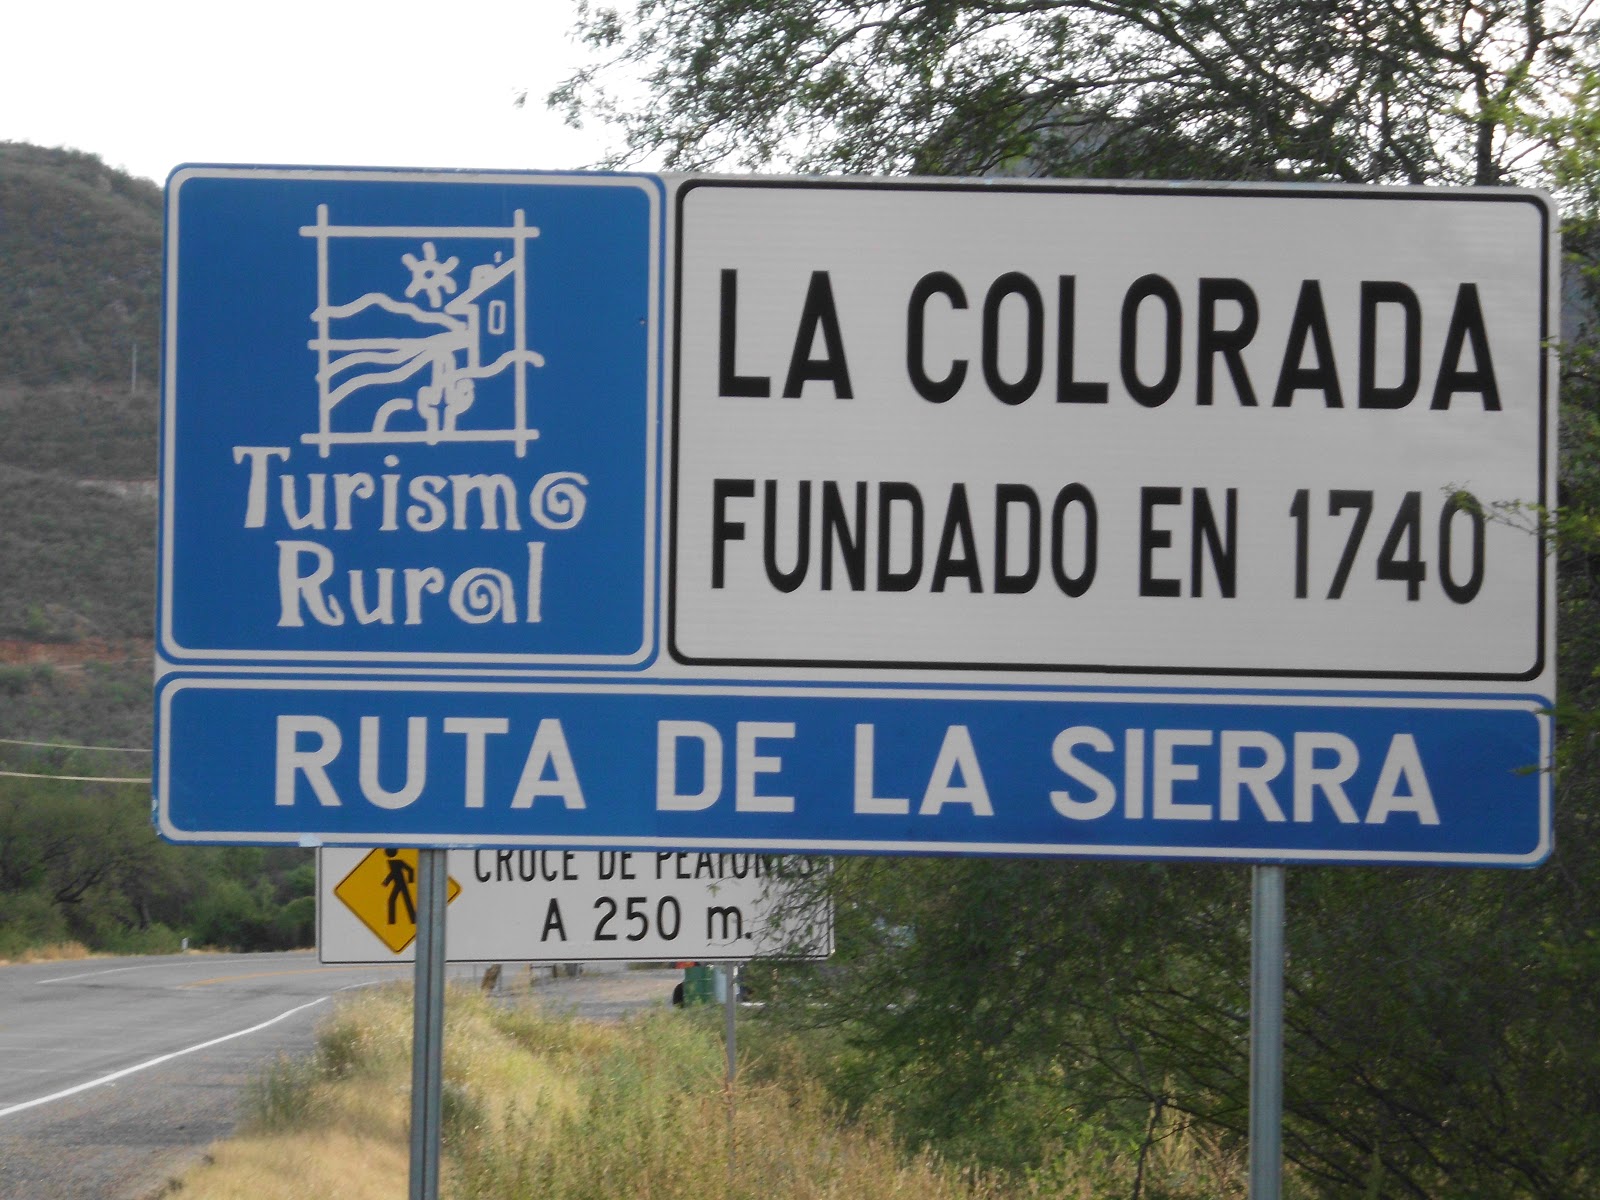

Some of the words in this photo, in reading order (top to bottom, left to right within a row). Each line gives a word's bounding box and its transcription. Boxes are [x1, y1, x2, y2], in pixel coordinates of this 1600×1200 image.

[718, 268, 854, 400] LA
[906, 270, 1503, 412] COLORADA
[233, 446, 589, 532] Turismo
[275, 540, 546, 628] Rural
[711, 478, 1099, 599] FUNDADO
[1138, 486, 1238, 599] EN
[1289, 488, 1486, 605] 1740
[275, 714, 586, 811] RUTA
[656, 719, 796, 814] DE
[854, 723, 994, 817] LA
[1050, 725, 1440, 826] SIERRA
[474, 850, 579, 883] CRUCE
[599, 851, 636, 881] DE
[540, 897, 568, 942] A
[593, 895, 681, 942] 250
[707, 905, 752, 940] m.
